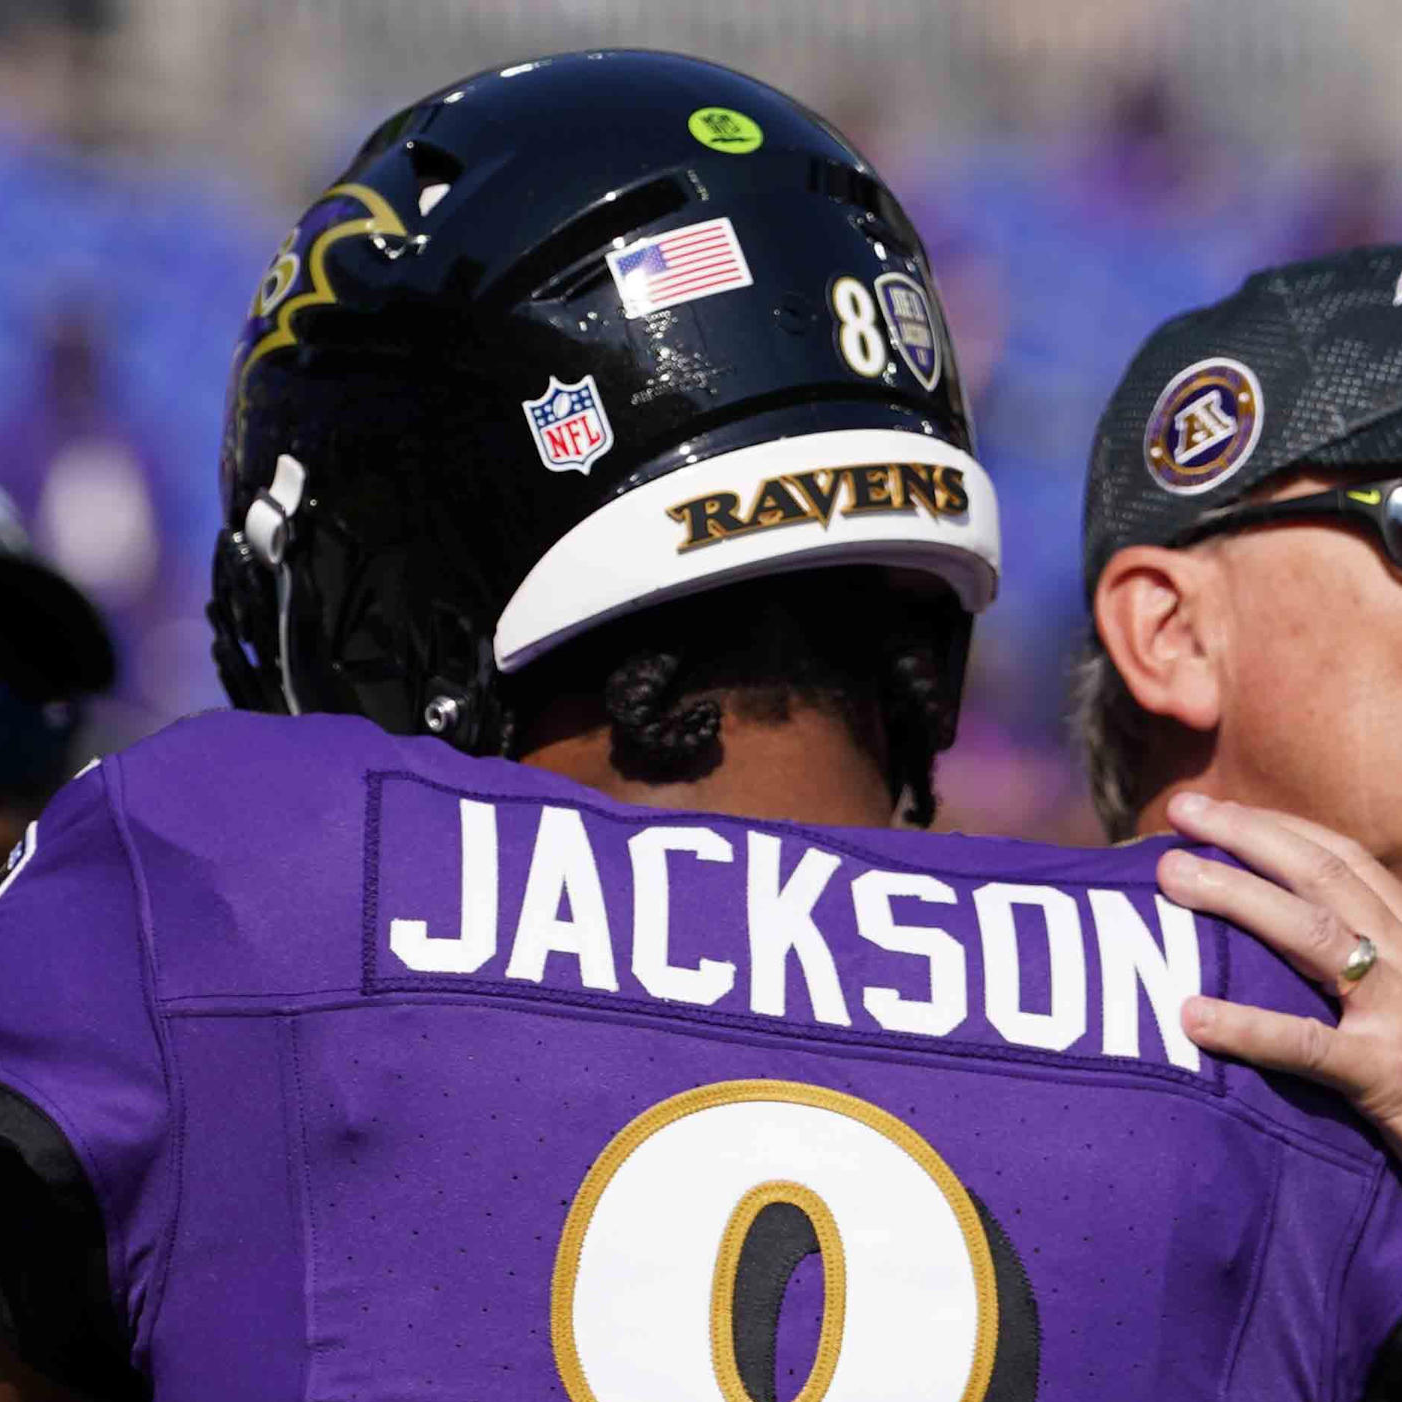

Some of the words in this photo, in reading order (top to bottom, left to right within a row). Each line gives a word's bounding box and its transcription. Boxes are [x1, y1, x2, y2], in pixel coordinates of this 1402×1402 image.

[831, 276, 886, 378] 8
[544, 414, 601, 459] NFL
[665, 461, 969, 554] RAVENS
[389, 798, 1201, 1073] JACKSON
